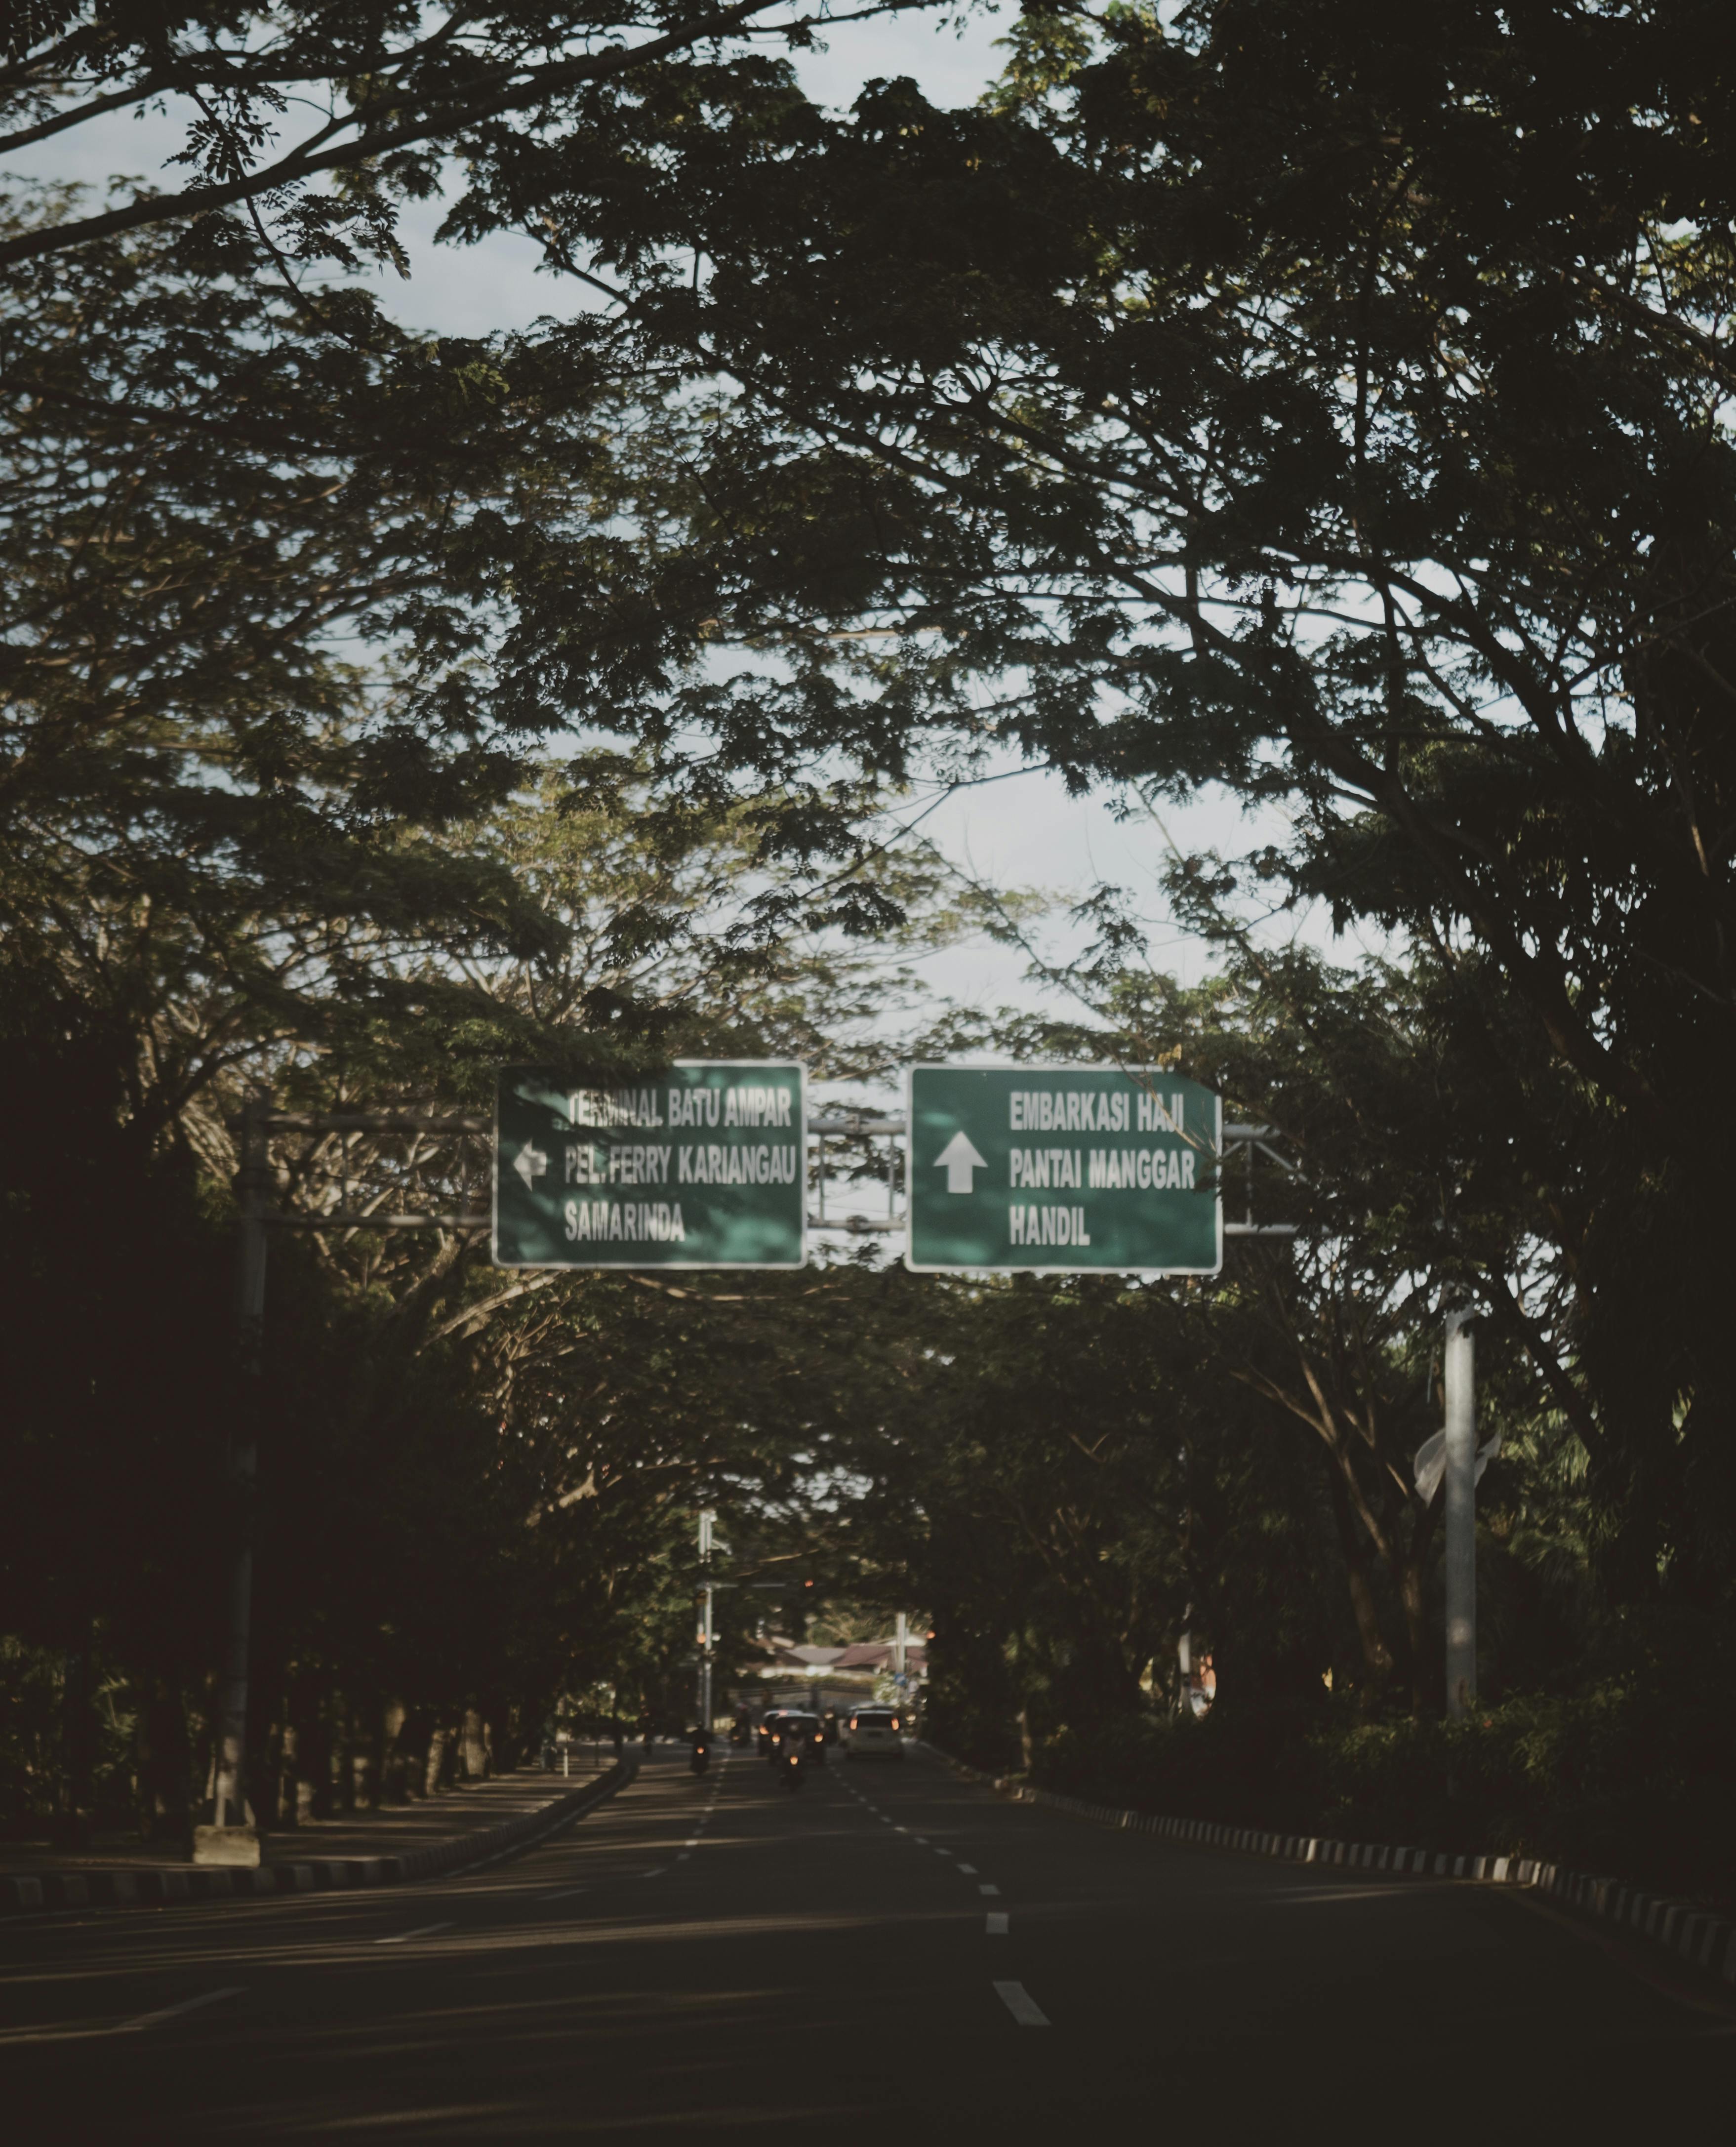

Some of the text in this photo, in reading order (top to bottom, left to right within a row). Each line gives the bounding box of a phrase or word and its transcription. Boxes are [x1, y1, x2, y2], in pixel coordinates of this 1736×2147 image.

[668, 1089, 720, 1127] BATU
[725, 1089, 791, 1127] AMPAR
[1010, 1092, 1184, 1132] EMBARKASI HAJI
[609, 1145, 672, 1184] FERRY
[679, 1145, 796, 1184] KARIANGAU
[1010, 1149, 1195, 1189] PANTAI MANGGAR
[565, 1201, 686, 1241] SAMARINDA
[1010, 1205, 1090, 1246] HANDIL
